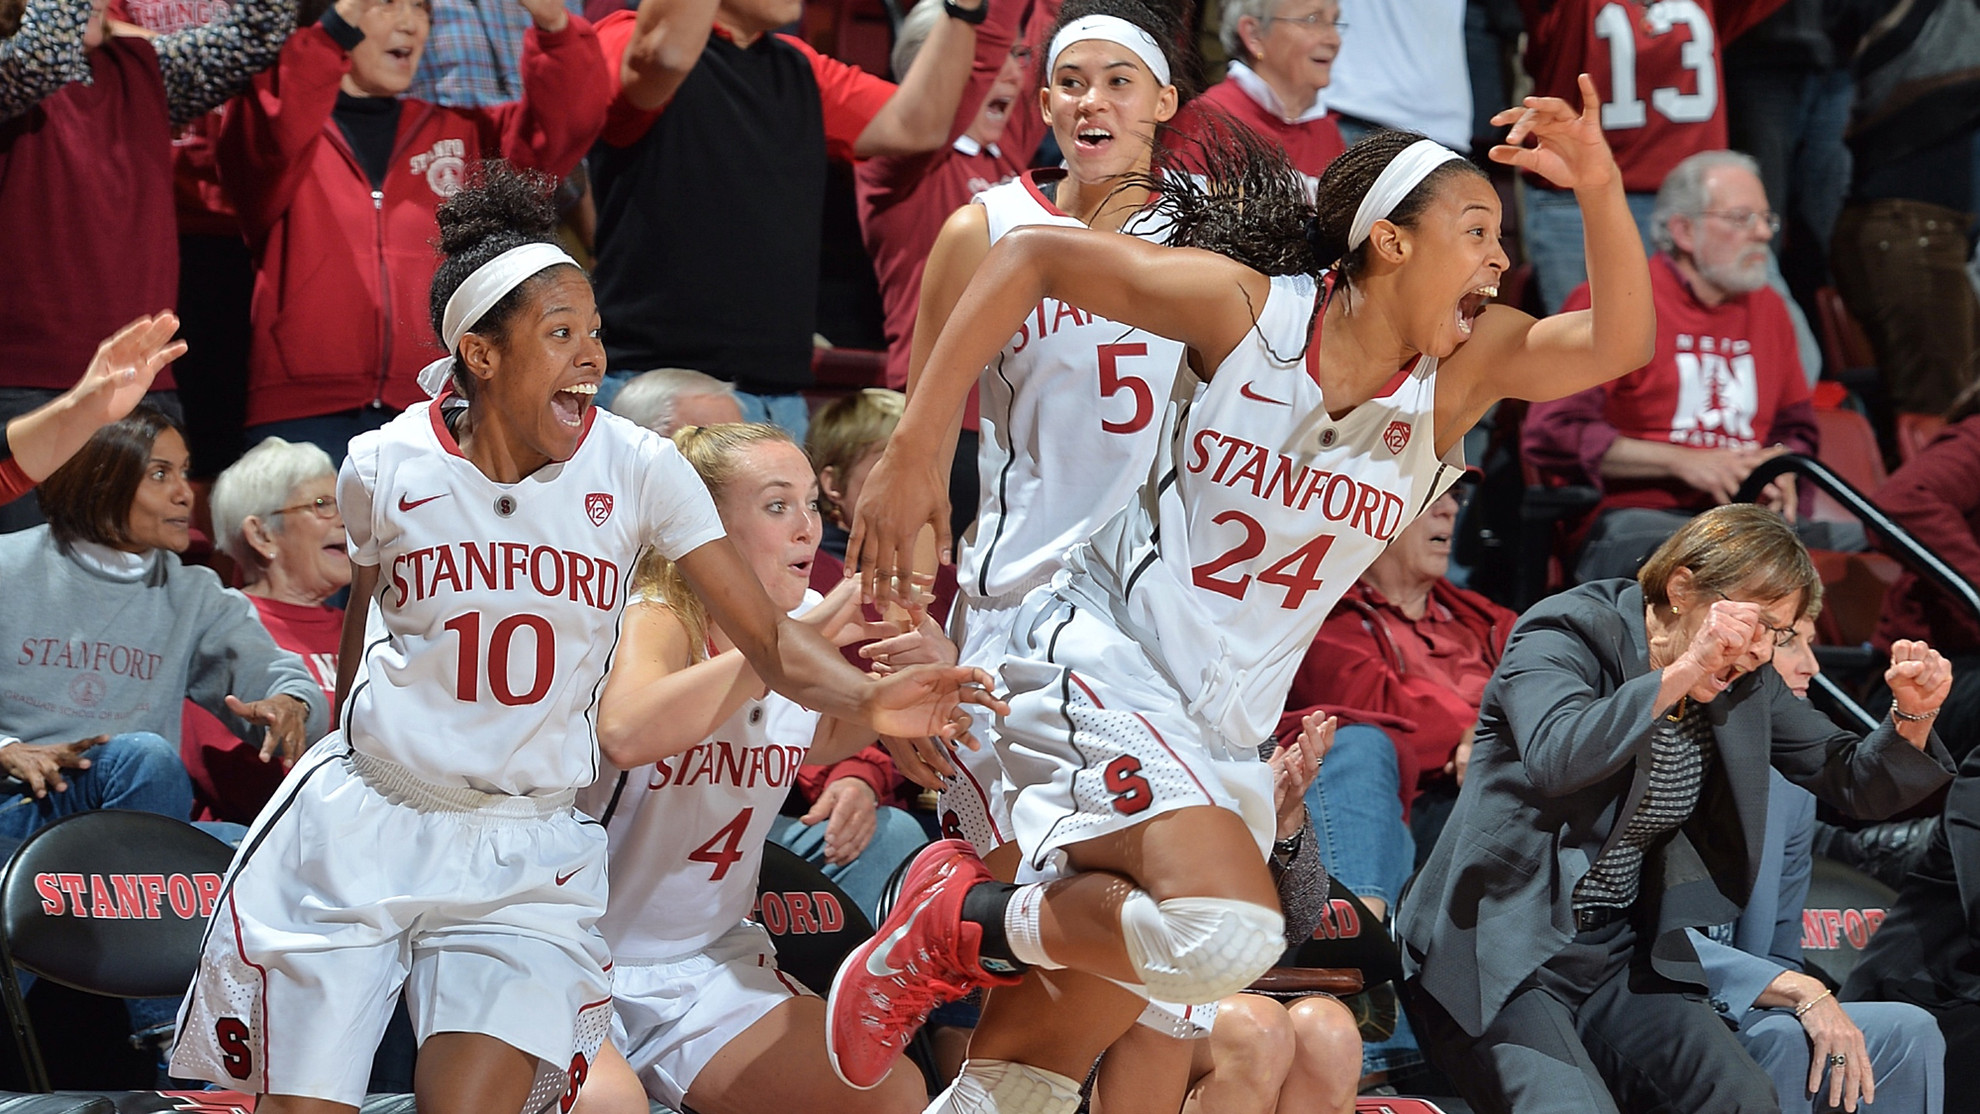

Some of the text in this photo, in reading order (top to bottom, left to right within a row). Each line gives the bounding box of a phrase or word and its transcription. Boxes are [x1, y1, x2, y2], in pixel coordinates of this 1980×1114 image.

[1594, 0, 1718, 130] 13
[1097, 342, 1155, 435] 5
[1389, 435, 1402, 448] 12
[592, 507, 605, 519] 12
[1186, 429, 1404, 541] STANFORD
[391, 541, 619, 612] STANFORD
[1191, 510, 1337, 610] 24
[444, 611, 556, 706] 10
[648, 741, 810, 790] STANFOR
[1102, 753, 1154, 817] S
[688, 806, 754, 882] 4
[34, 872, 227, 920] STANFOR
[214, 1016, 253, 1081] S
